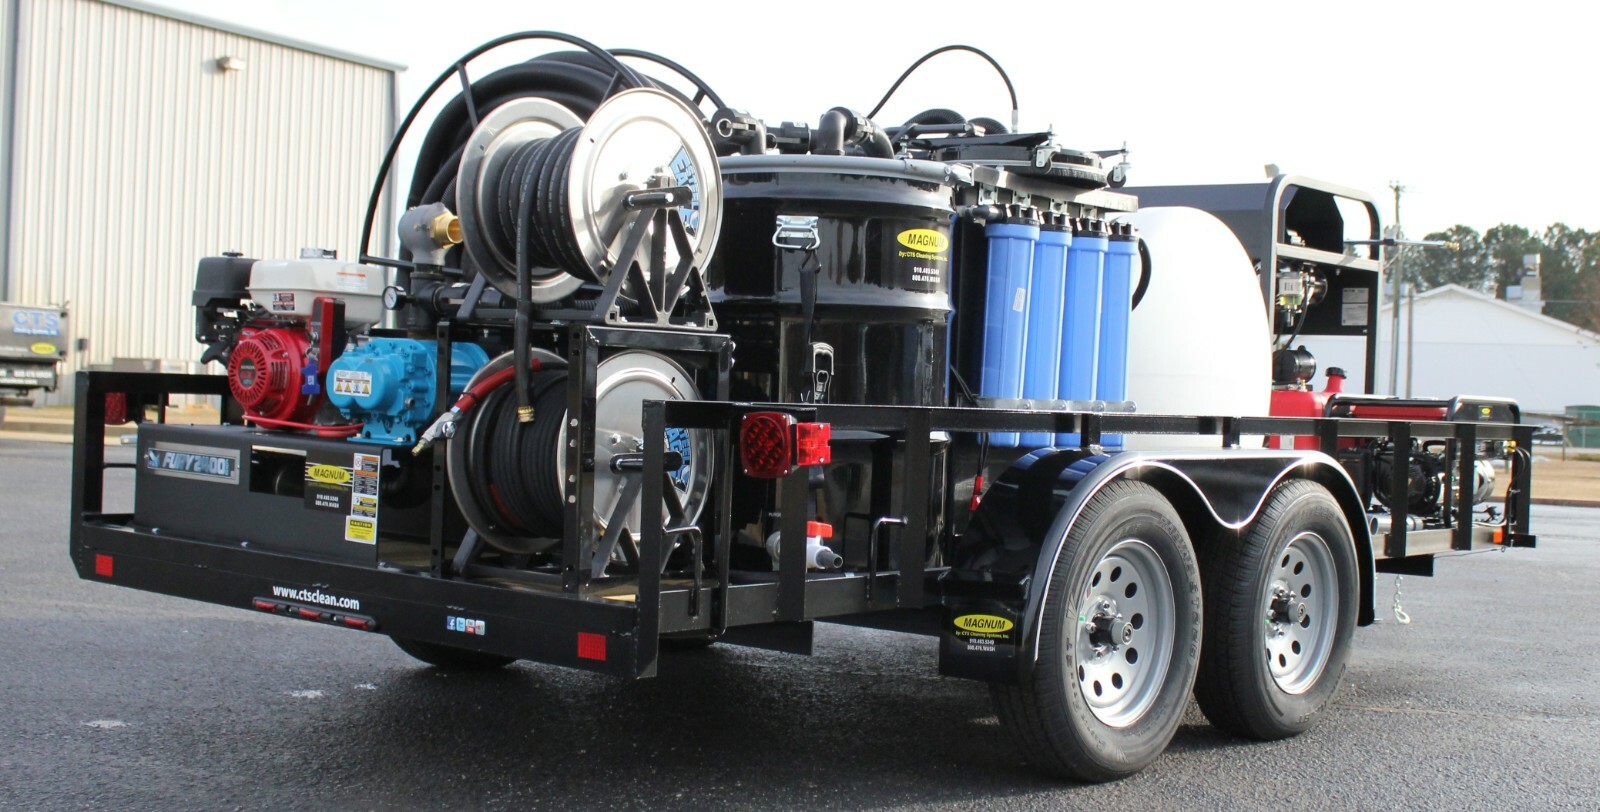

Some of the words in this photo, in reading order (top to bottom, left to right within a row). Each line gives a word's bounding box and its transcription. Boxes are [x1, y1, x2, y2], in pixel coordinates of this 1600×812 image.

[908, 234, 945, 248] MAGNUM
[12, 309, 59, 328] CTS
[313, 468, 345, 480] MAGNUM
[272, 585, 360, 611] www.ctsclean.com
[964, 618, 1006, 630] MAGNUM
